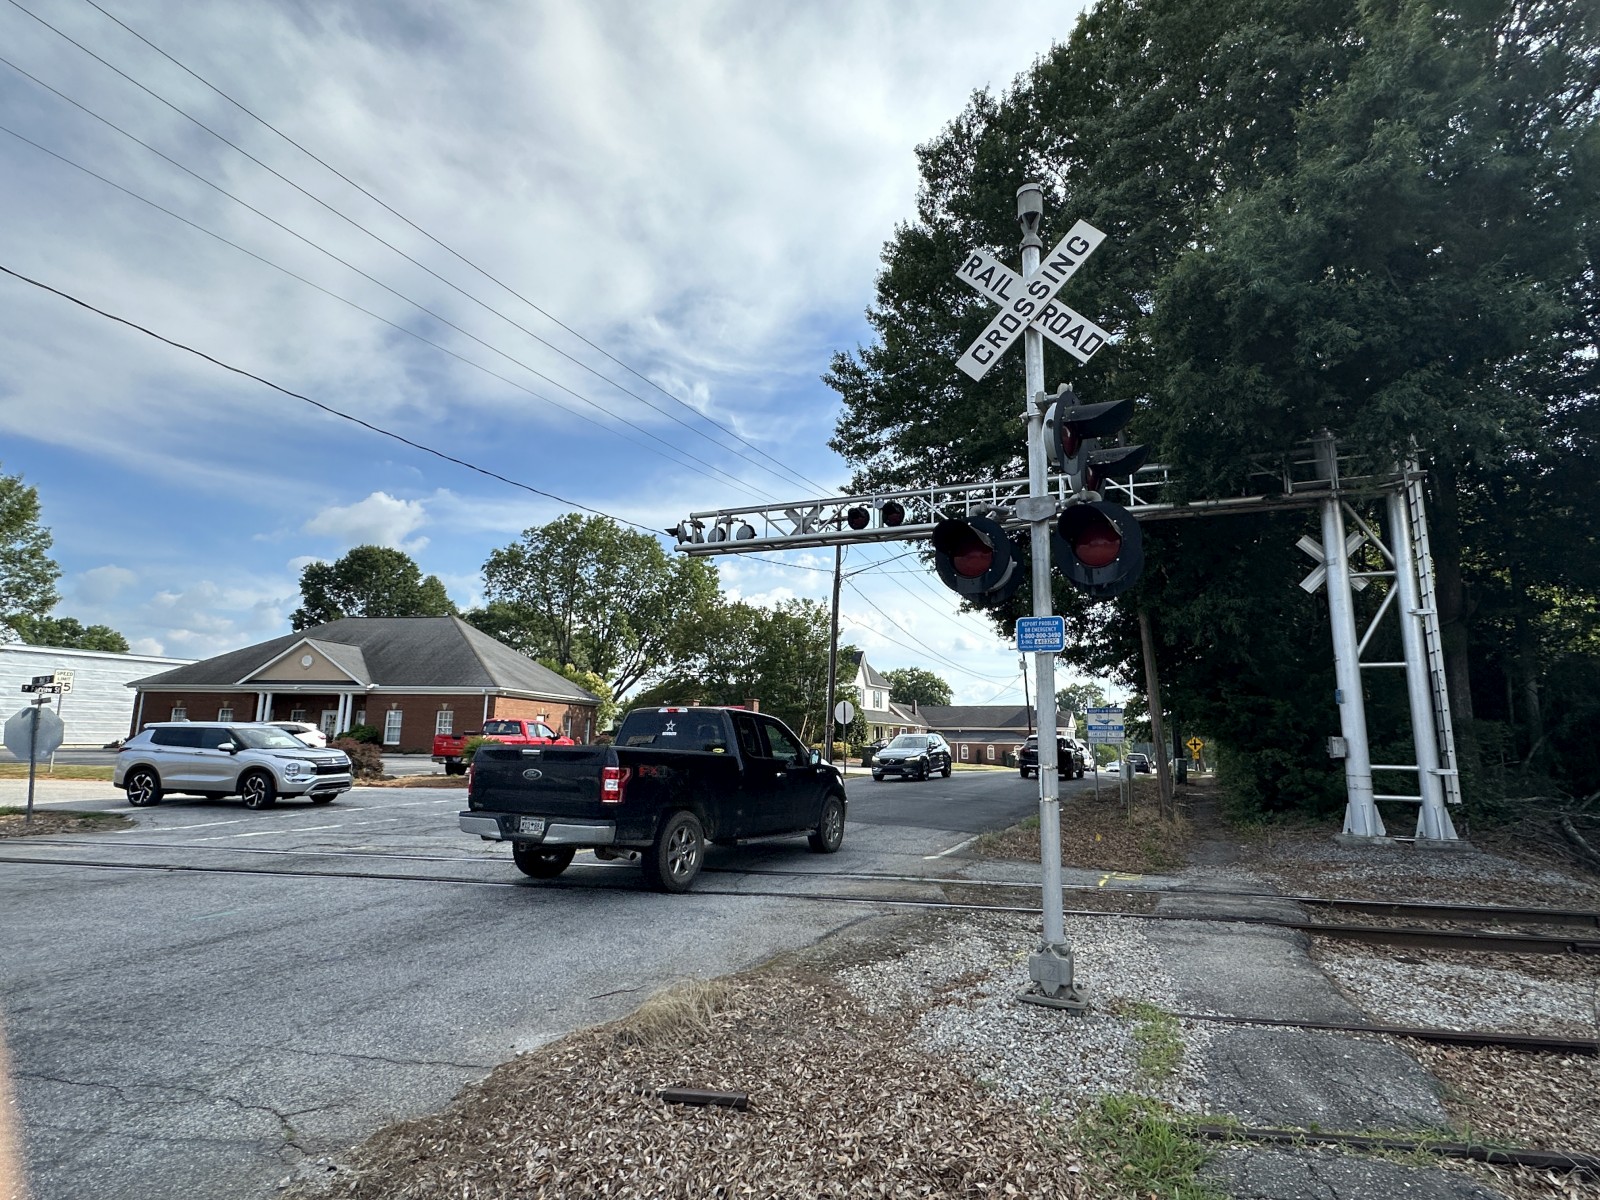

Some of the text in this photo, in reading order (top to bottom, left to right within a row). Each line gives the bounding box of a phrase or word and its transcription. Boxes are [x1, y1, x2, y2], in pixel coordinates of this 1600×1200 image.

[962, 254, 1104, 356] RAIL ROAD
[971, 235, 1090, 365] CROSSING
